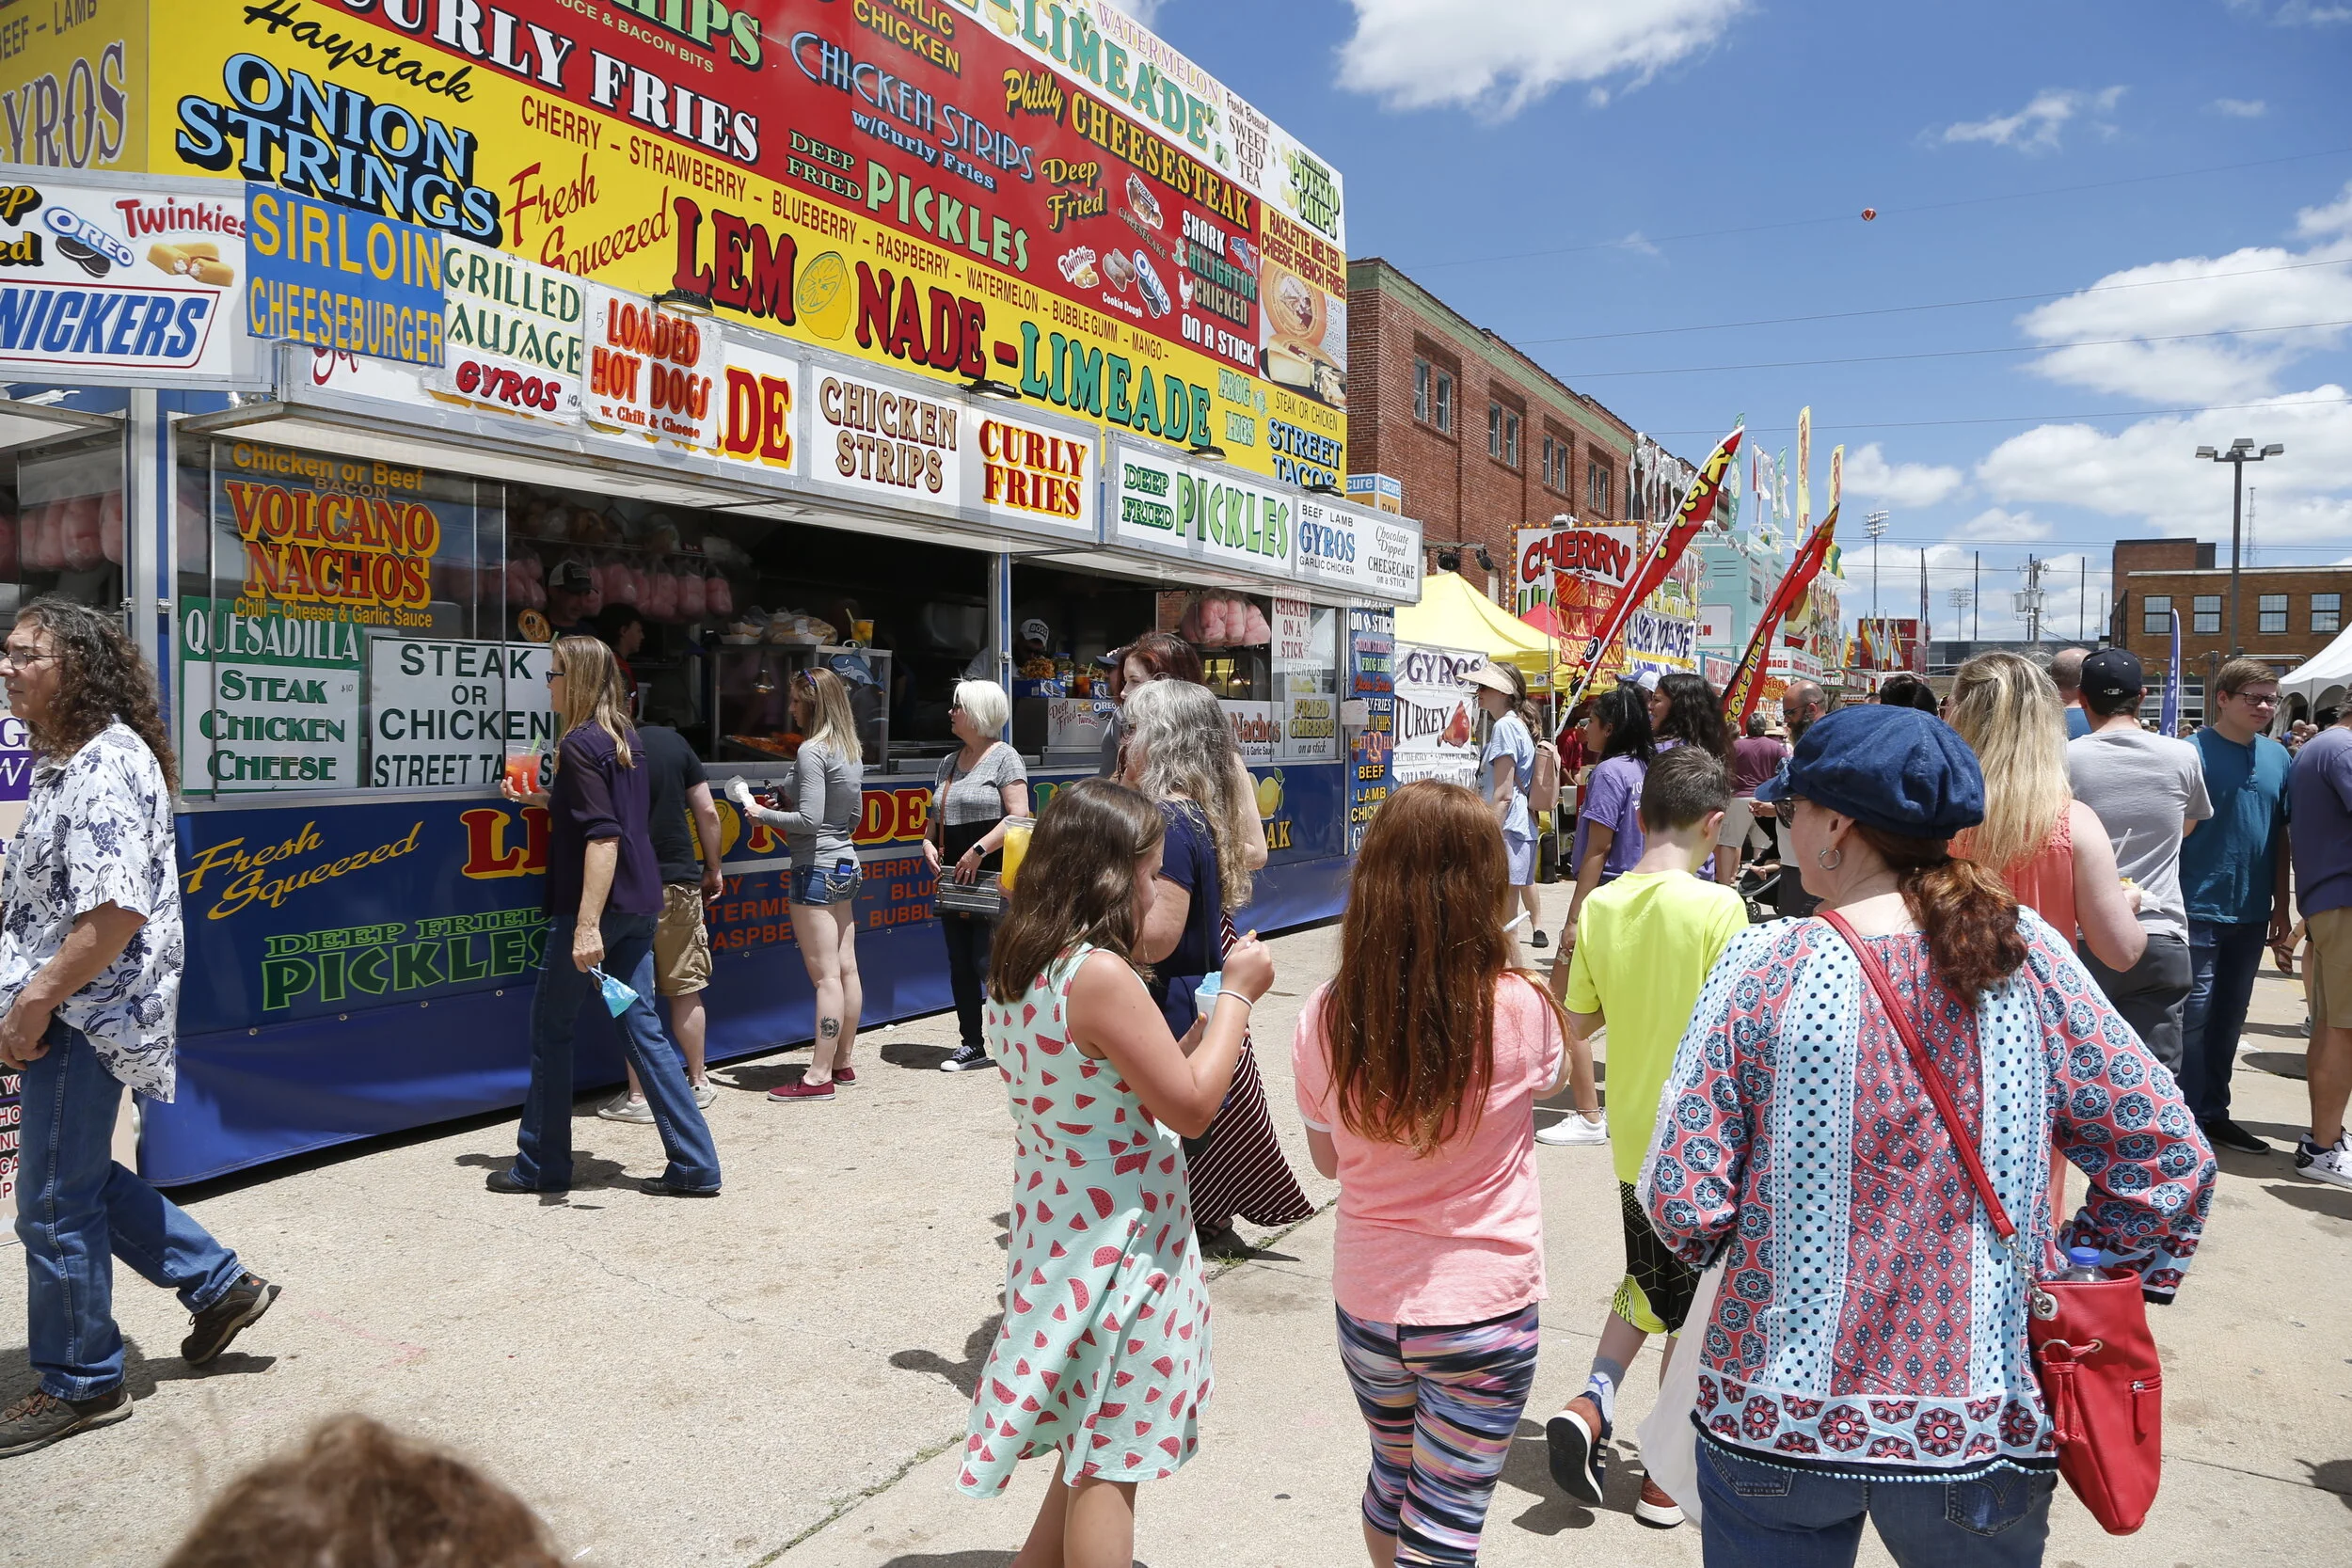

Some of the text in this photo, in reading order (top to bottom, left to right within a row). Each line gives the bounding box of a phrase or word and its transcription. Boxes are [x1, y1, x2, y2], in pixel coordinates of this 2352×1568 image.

[243, 0, 474, 103] Haystack
[618, 19, 675, 55] BACON
[679, 52, 714, 73] BITS
[853, 0, 961, 74] CHICKEN
[1096, 0, 1220, 103] WATERMELON
[1022, 0, 1209, 153] LIMEADE
[0, 40, 126, 170] YROS
[223, 52, 477, 179] ONION
[591, 49, 761, 163] FRIES
[790, 31, 1035, 181] CHICKEN STRIPS
[1227, 91, 1270, 135] Fresh Brewed
[788, 130, 855, 172] DEEP
[850, 109, 995, 190] w/Curly Fries
[1003, 69, 1251, 231] Philly CHEESESTEAK
[1229, 115, 1267, 155] SWEET
[1235, 139, 1263, 169] ICED
[176, 96, 501, 241] STRINGS
[787, 156, 863, 200] FRIED
[1041, 158, 1098, 187] Deep
[1238, 161, 1261, 189] TEA
[1289, 154, 1341, 216] POTATO
[504, 151, 599, 247] Fresh
[866, 159, 1029, 274] PICKLES
[1046, 188, 1104, 231] Fried
[1295, 188, 1338, 241] CHIPS
[43, 206, 135, 268] OREO
[251, 193, 442, 293] SIRLOIN
[521, 95, 602, 150] CHERRY
[629, 135, 747, 202] STRAWBERRY
[772, 190, 857, 245] BLUEBERRY
[876, 236, 950, 280] RASPBERRY
[967, 265, 1039, 314] WATERMELON
[1053, 299, 1089, 333] BUBBLE
[1132, 332, 1163, 362] MANGO
[540, 185, 671, 278] Squeezed
[1118, 206, 1168, 261] CHEESECAKE
[1182, 209, 1225, 257] SHARK
[1269, 210, 1340, 273] RACLETTE MELTED
[444, 247, 581, 325] GRILLED
[1135, 250, 1171, 314] OREO
[1188, 244, 1257, 303] ALLIGATOR
[1262, 231, 1346, 300] CHEESE FRENCH FRIES
[250, 276, 444, 365] CHEESEBURGER
[1103, 292, 1143, 319] Cookie Dough
[1194, 277, 1249, 329] CHICKEN
[608, 297, 701, 368] LOADED
[1182, 313, 1256, 369] ON A STICK
[455, 360, 562, 412] GYROS
[590, 345, 713, 421] HOT DOGS
[1020, 321, 1211, 448] LIMEADE
[1218, 368, 1251, 407] FROG
[616, 408, 645, 427] Chili
[648, 414, 659, 429] &
[661, 419, 700, 439] Cheese
[819, 376, 958, 451] CHICKEN
[1225, 410, 1256, 448] LEGS
[1276, 391, 1338, 433] STEAK OR CHICKEN
[835, 429, 943, 494] STRIPS
[978, 420, 1088, 483] CURLY
[1267, 417, 1343, 471] STREET
[232, 442, 424, 491] Chicken or Beef
[314, 477, 389, 499] BACON
[1123, 463, 1169, 498] DEEP
[1272, 453, 1338, 489] TACOS
[982, 462, 1083, 520] FRIES
[1121, 495, 1174, 531] FRIED
[225, 479, 440, 558] VOLCANO
[1176, 471, 1289, 561] PICKLES
[1302, 504, 1354, 528] BEEF LAMB
[1375, 525, 1409, 545] Chocolate
[1298, 520, 1356, 563] GYROS
[1377, 539, 1407, 559] Dipped
[1522, 530, 1631, 584] CHERRY
[243, 540, 432, 610] NACHOS
[1299, 555, 1355, 576] GARLIC CHICKEN
[1367, 555, 1416, 579] CHEESECAKE
[1390, 578, 1406, 588] STICK
[234, 597, 433, 627] Chili Cheese & Garlic Sauce
[1275, 598, 1310, 618] CHICKEN
[1283, 618, 1302, 638] ON A
[1350, 611, 1394, 634] ON A STICK
[185, 608, 360, 661] QUESADILLA
[1280, 641, 1304, 658] STICK
[401, 643, 532, 679] STEAK
[1286, 662, 1322, 677] CHURROS
[1362, 657, 1376, 672] FROG
[1377, 657, 1391, 672] LEGS
[220, 669, 328, 705] STEAK
[452, 684, 487, 705] OR
[1049, 700, 1069, 718] Deep
[1093, 701, 1117, 712] OREO
[1294, 698, 1330, 719] FRIED
[1374, 698, 1391, 712] FRIES
[199, 708, 345, 743] CHICKEN
[379, 710, 552, 740] CHICKEN
[1057, 705, 1076, 735] Fried
[1231, 711, 1280, 743] Nachos
[1288, 719, 1334, 739] CHEESE
[1375, 715, 1391, 732] CHIPS
[1394, 695, 1451, 748] TURKEY
[207, 750, 338, 782] CHEESE
[1311, 740, 1326, 753] stick
[374, 753, 469, 787] STREET
[1358, 764, 1385, 780] BEEF
[1357, 786, 1388, 802] LAMB
[180, 821, 325, 895] Fresh
[206, 821, 424, 921] Squeezed
[264, 922, 407, 958] DEEP
